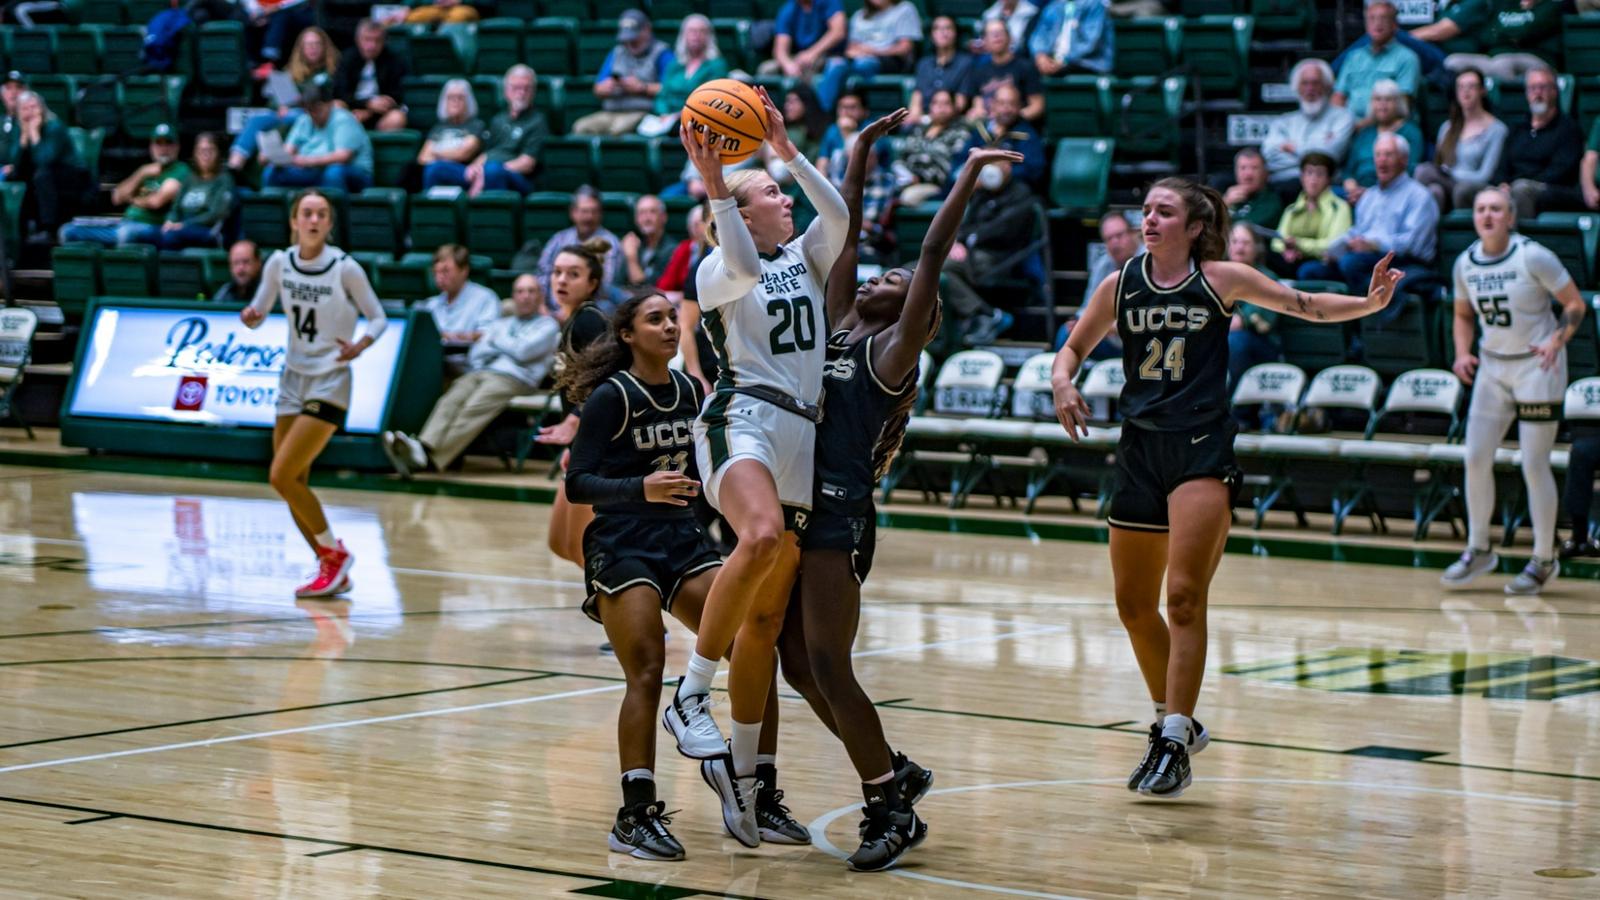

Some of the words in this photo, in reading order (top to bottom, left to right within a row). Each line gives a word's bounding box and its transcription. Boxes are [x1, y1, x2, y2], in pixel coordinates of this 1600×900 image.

[282, 279, 333, 296] COLORADO
[290, 289, 319, 303] STATE
[292, 304, 318, 342] 14
[767, 296, 816, 355] 20
[1126, 305, 1211, 333] UCCS
[1478, 296, 1511, 327] 55
[1139, 337, 1186, 381] 24
[214, 383, 279, 406] TOYOT
